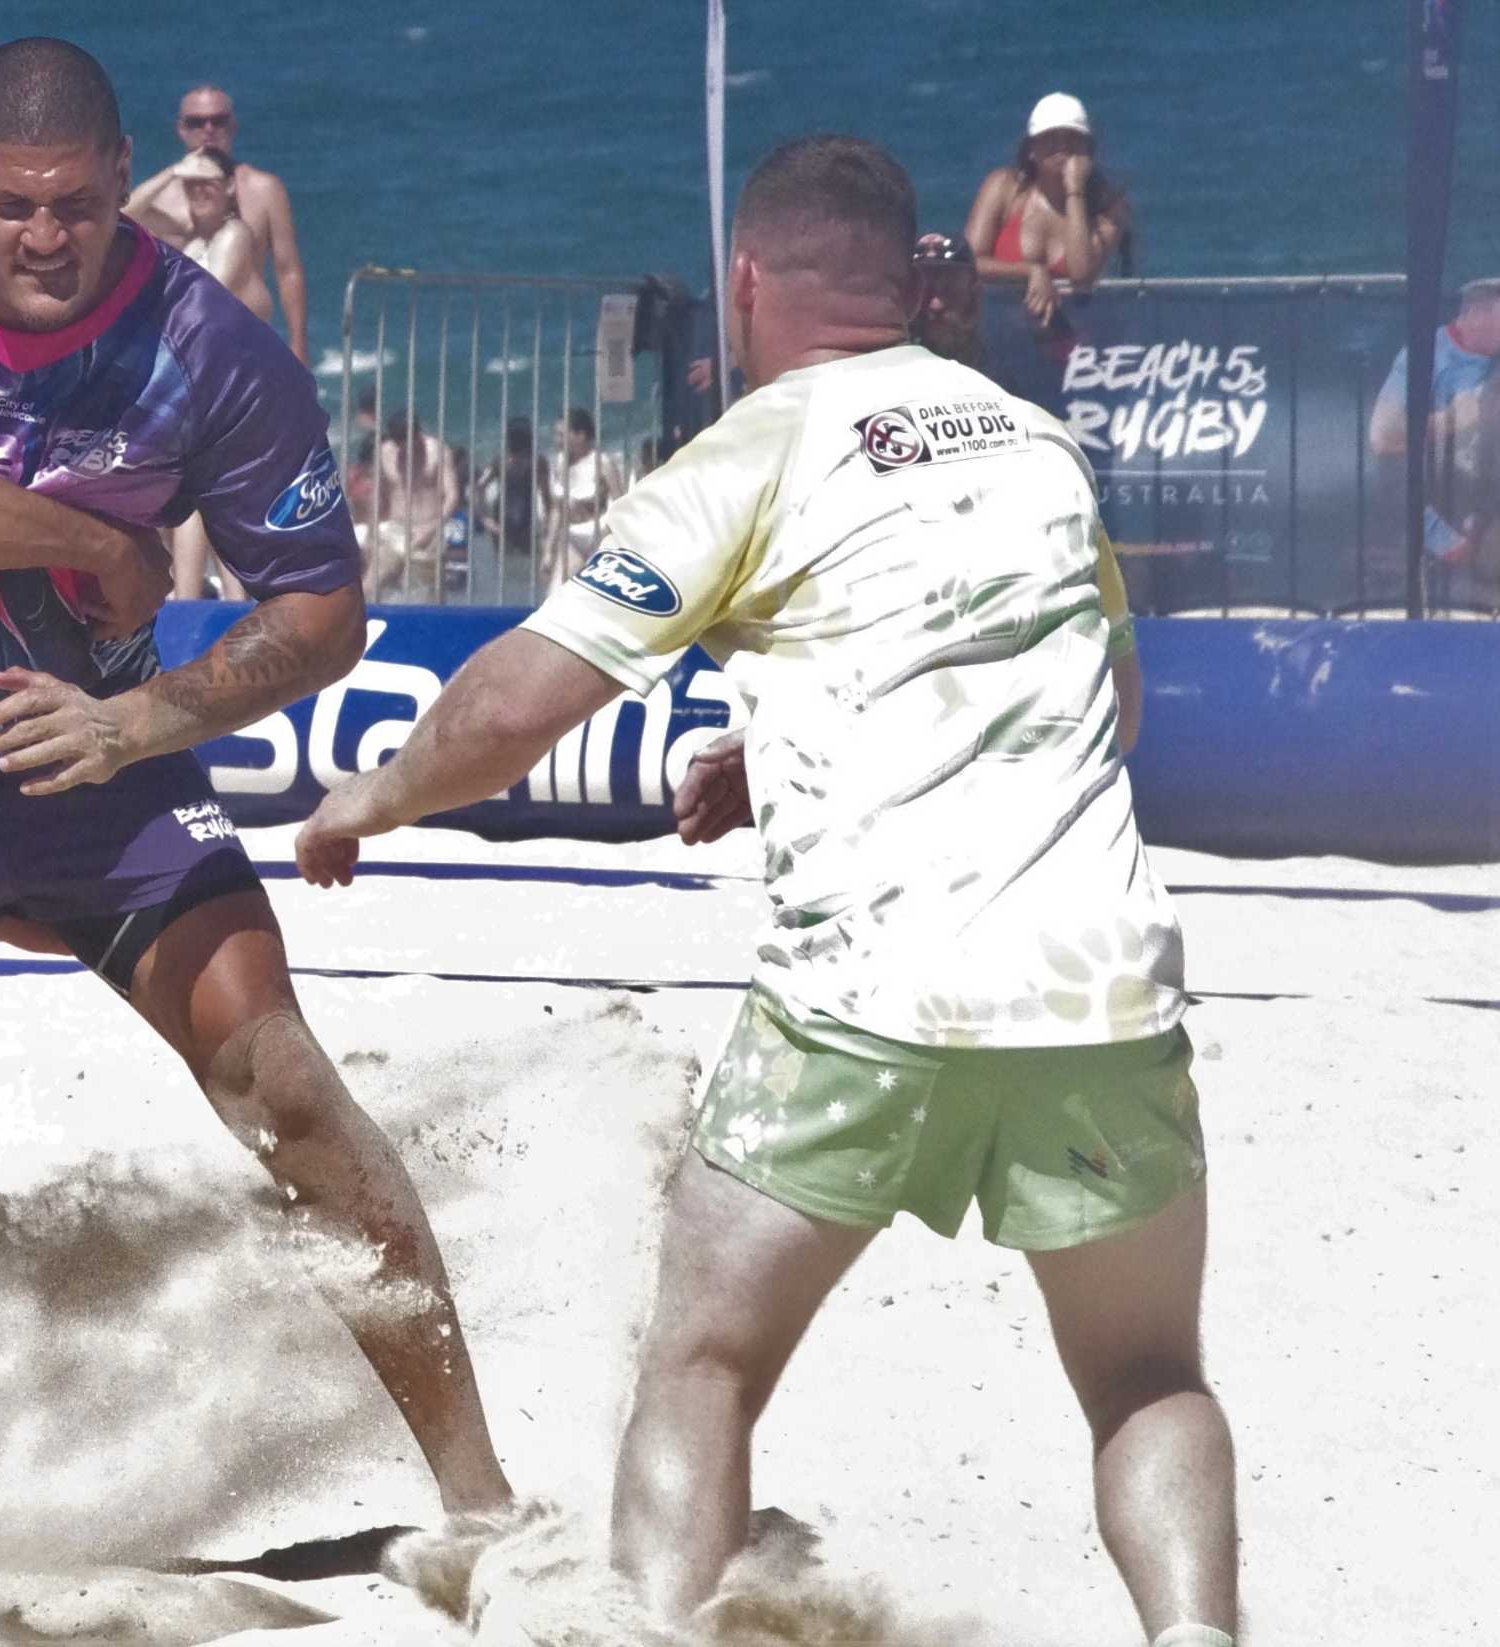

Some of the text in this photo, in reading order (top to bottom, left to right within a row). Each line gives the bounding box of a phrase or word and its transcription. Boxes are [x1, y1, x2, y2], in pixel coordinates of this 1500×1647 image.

[1062, 339, 1221, 397] BEACH
[919, 402, 1003, 420] DIAL BEFORE
[925, 414, 1016, 442] YOU DIG
[1064, 391, 1267, 463] RUGBY
[1098, 484, 1268, 504] USTRALIA
[580, 555, 659, 601] Ford
